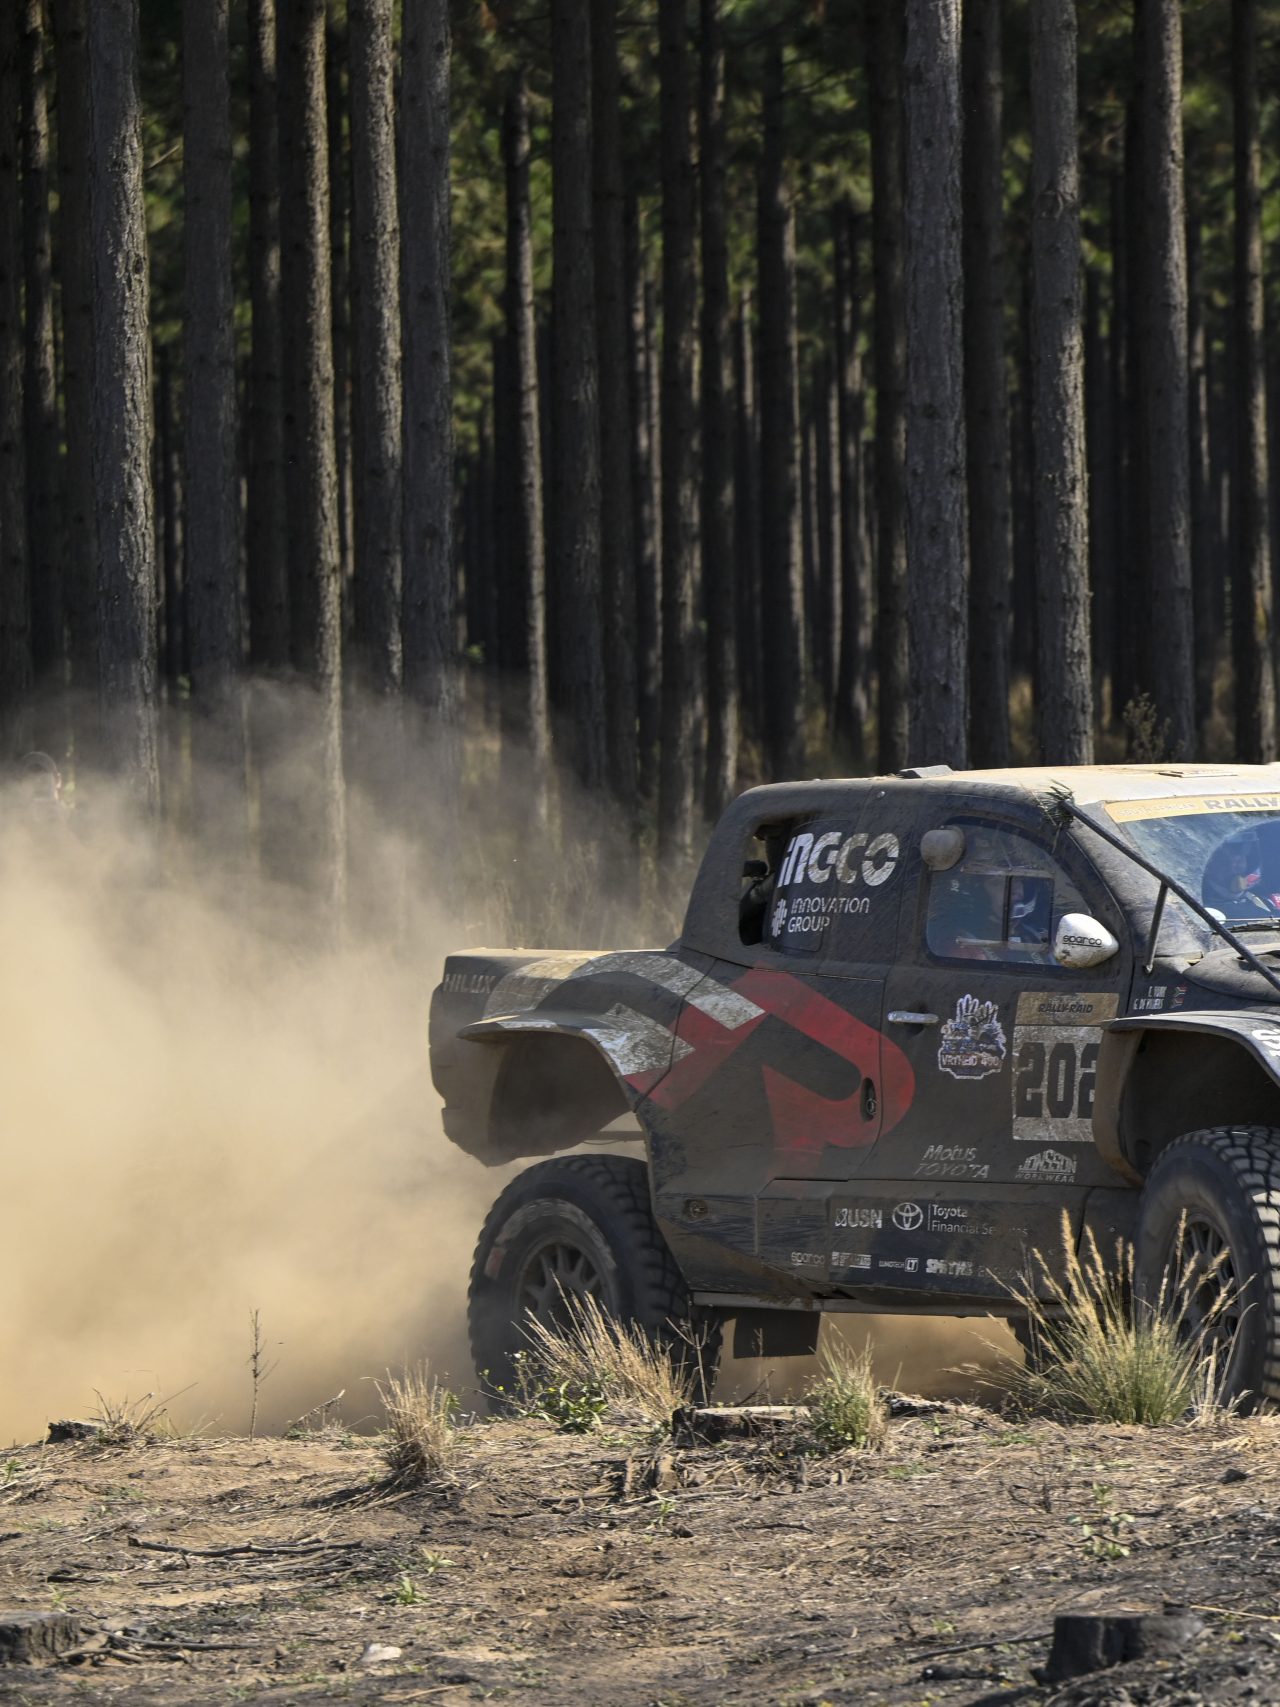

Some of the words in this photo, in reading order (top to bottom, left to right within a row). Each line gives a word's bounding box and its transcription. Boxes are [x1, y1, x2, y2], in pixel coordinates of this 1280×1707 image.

[791, 897, 871, 914] INNOVATION
[788, 916, 830, 933] GROUP
[1063, 935, 1102, 946] sparco
[1038, 1003, 1093, 1014] RALLY-RAID
[1018, 1149, 1077, 1174] JONSSON
[914, 1163, 990, 1178] TOYOTA
[932, 1204, 967, 1219] Toyota
[931, 1220, 978, 1235] Financial
